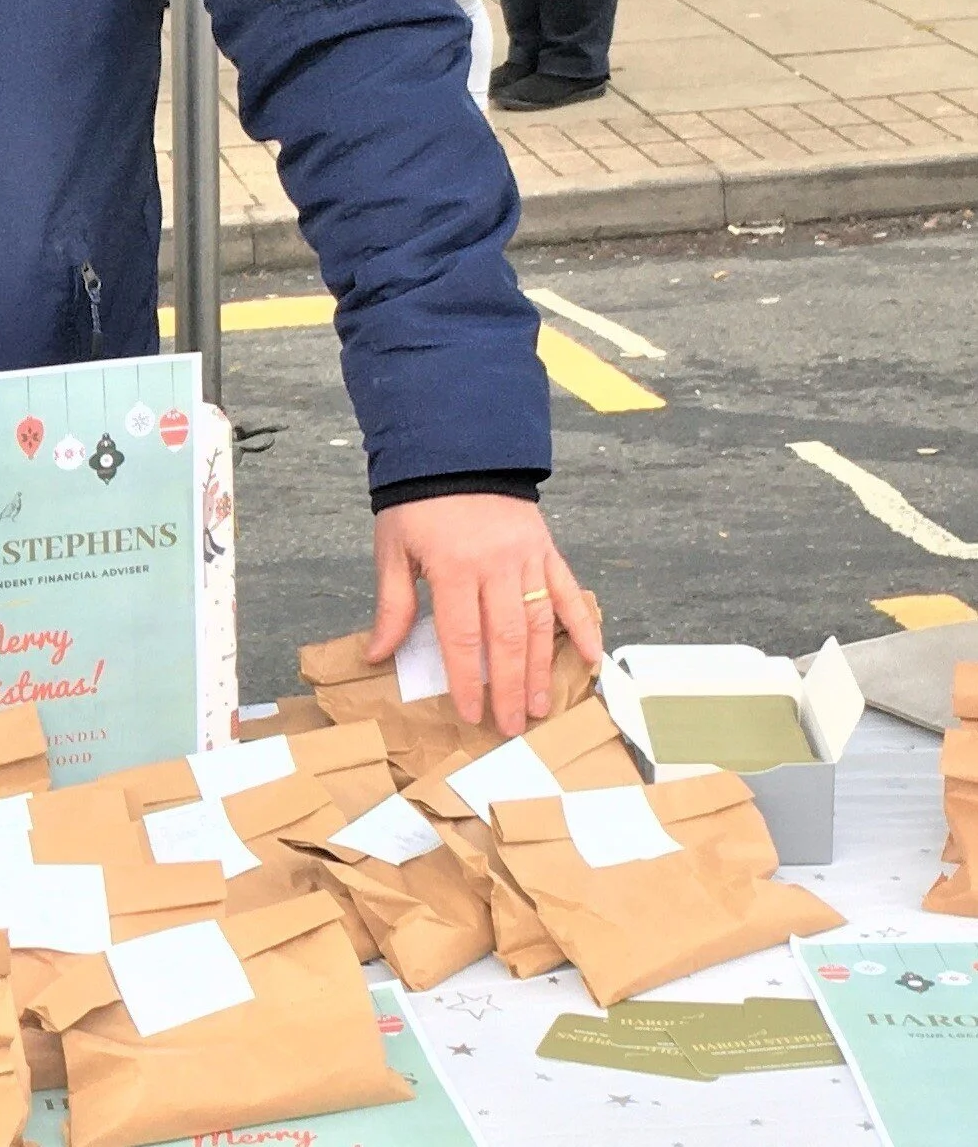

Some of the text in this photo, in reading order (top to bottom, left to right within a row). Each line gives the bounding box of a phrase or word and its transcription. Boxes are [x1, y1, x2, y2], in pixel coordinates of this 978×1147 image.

[2, 522, 178, 566] STEPHENS
[38, 570, 97, 584] FINANCIAL
[102, 564, 150, 578] ADVISER
[47, 728, 108, 747] IENDLY
[53, 752, 92, 766] OOD
